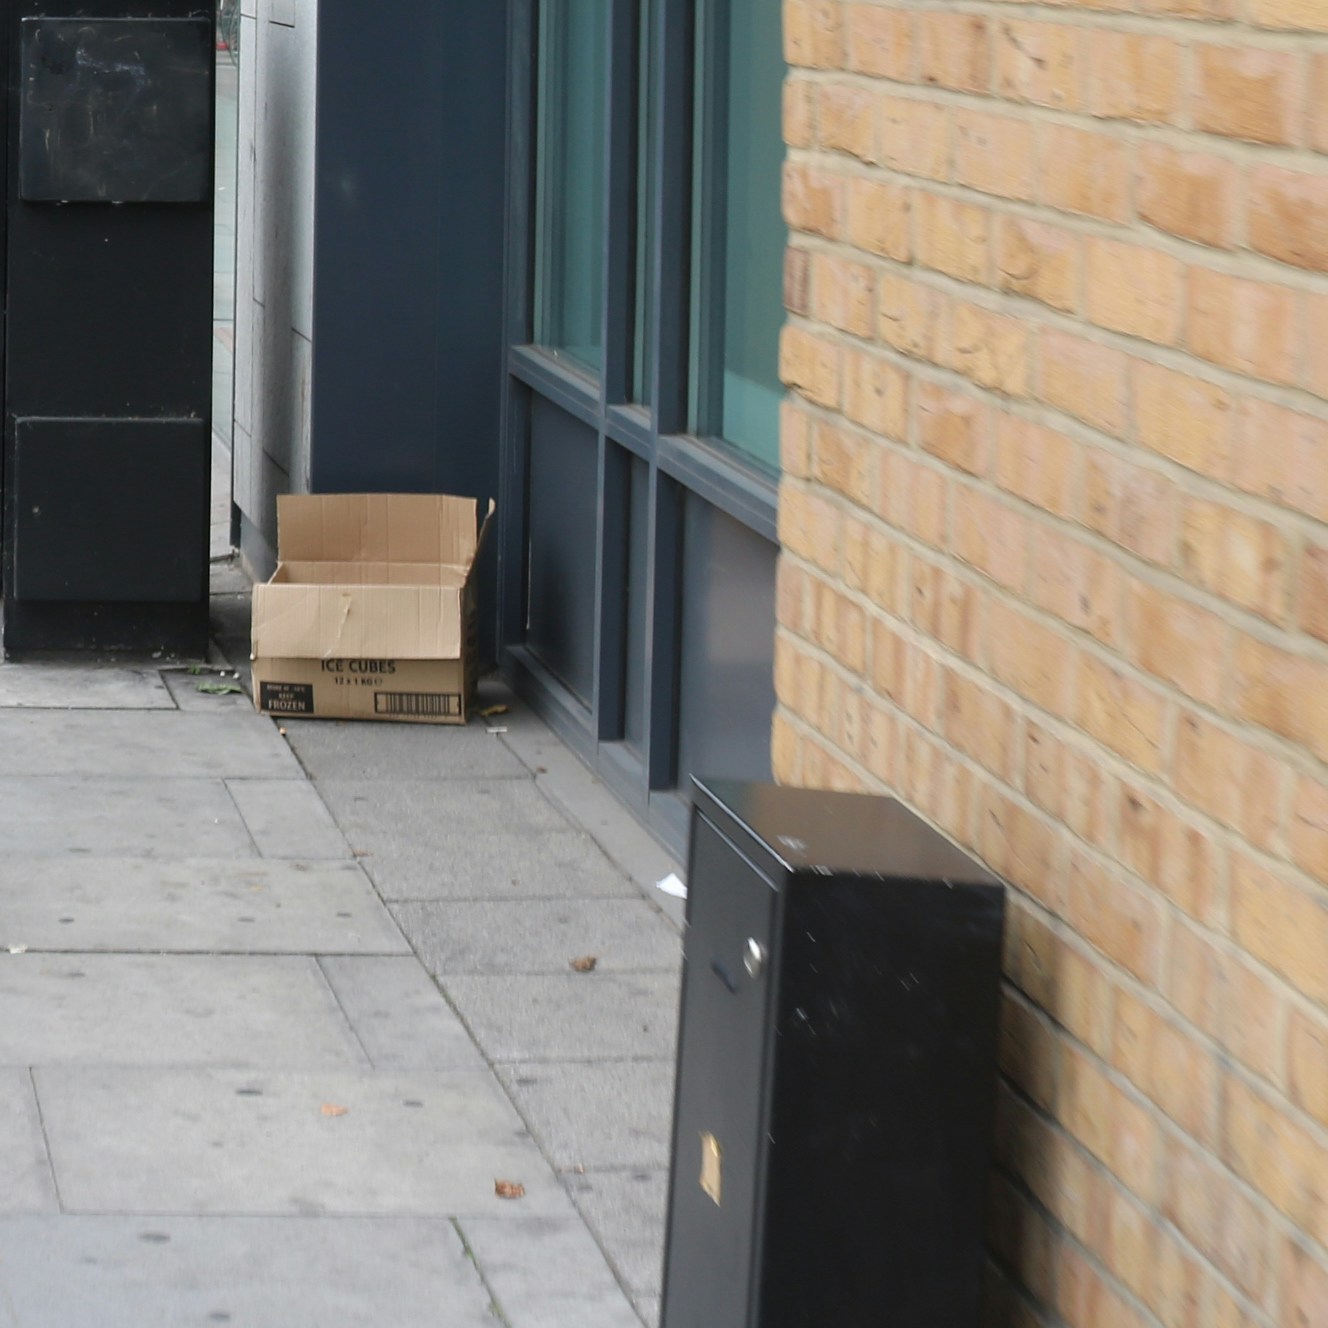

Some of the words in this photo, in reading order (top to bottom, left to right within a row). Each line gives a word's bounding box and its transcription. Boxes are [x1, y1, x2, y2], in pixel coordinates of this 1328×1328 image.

[320, 659, 344, 672] ICE
[348, 659, 396, 673] CUBES
[268, 699, 306, 711] FROZEN
